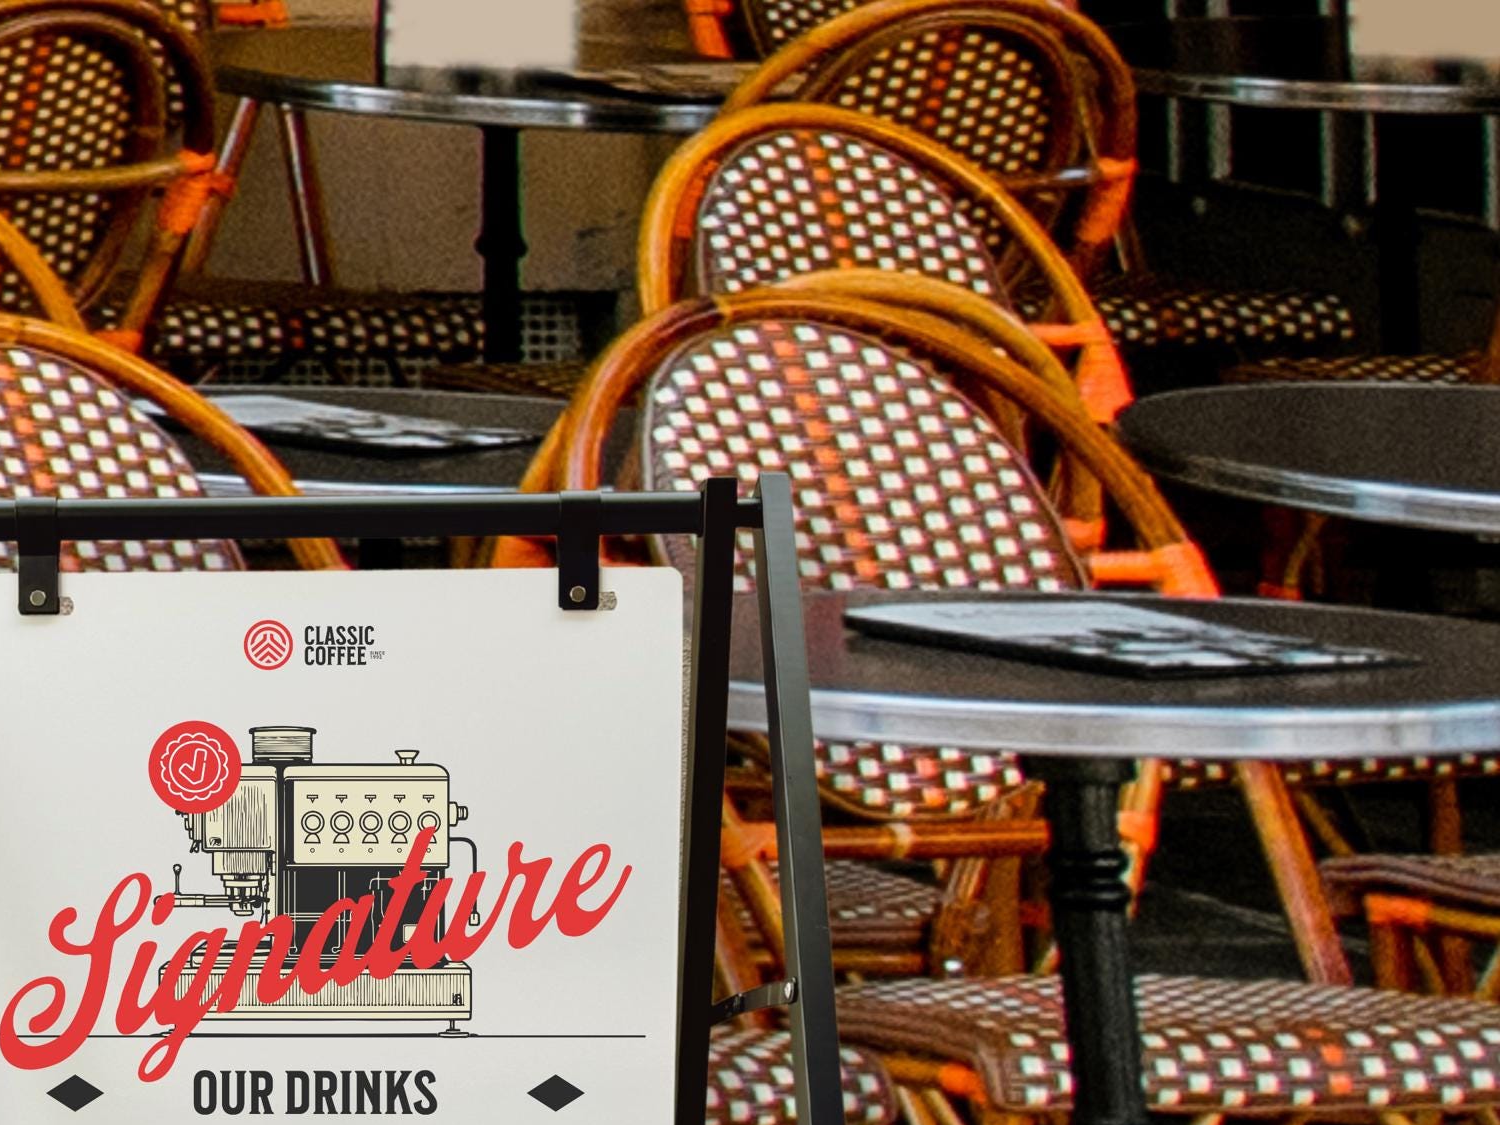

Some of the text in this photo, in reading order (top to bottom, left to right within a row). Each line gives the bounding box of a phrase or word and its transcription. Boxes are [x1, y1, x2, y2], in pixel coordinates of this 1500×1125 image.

[305, 626, 374, 645] CLASSIC
[305, 646, 366, 665] COFFEE
[0, 826, 632, 1082] Signature
[194, 1070, 437, 1115] OUR DRINKS
